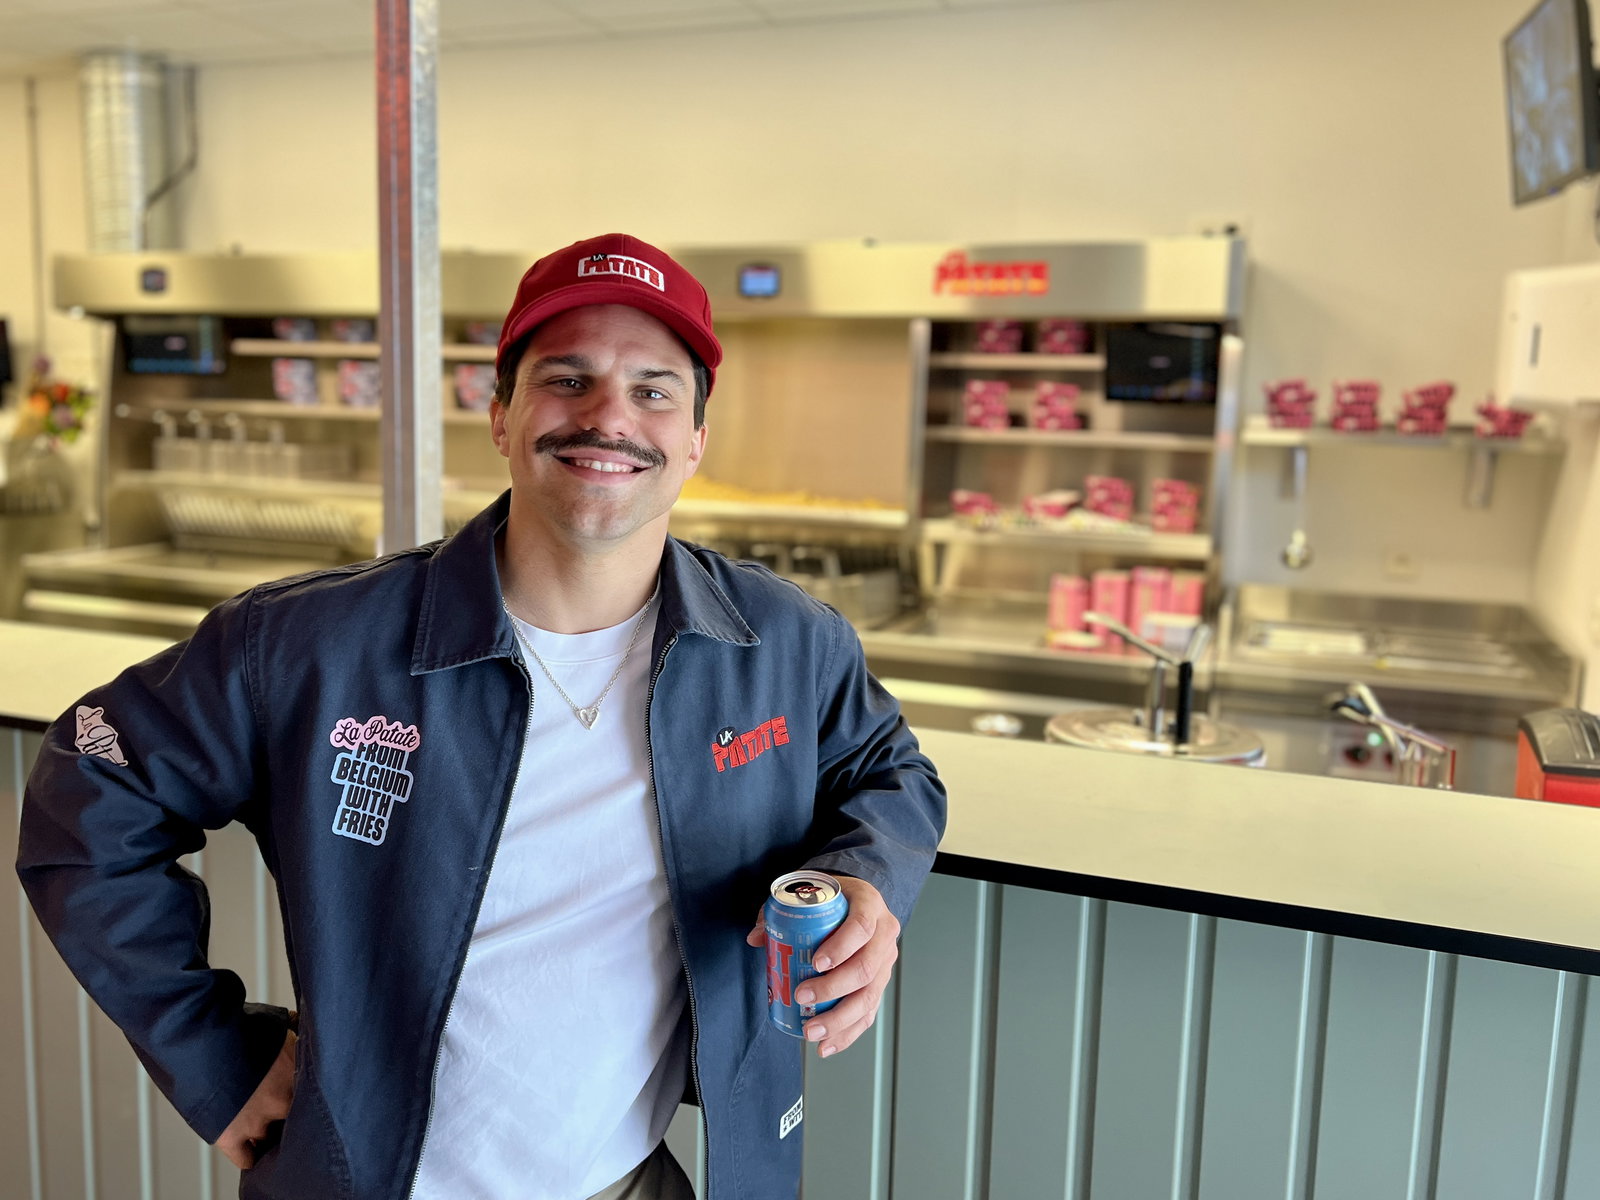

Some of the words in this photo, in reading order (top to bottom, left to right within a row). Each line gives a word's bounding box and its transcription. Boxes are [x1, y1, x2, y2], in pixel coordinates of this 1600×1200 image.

[583, 257, 660, 288] PATATE
[334, 721, 360, 746] La
[363, 719, 418, 748] Patate
[711, 715, 790, 773] PATATE
[719, 730, 733, 746] LA
[355, 740, 406, 770] FROM
[335, 756, 410, 799] BELGIUM
[345, 784, 393, 818] WITH
[336, 807, 386, 841] FRIES
